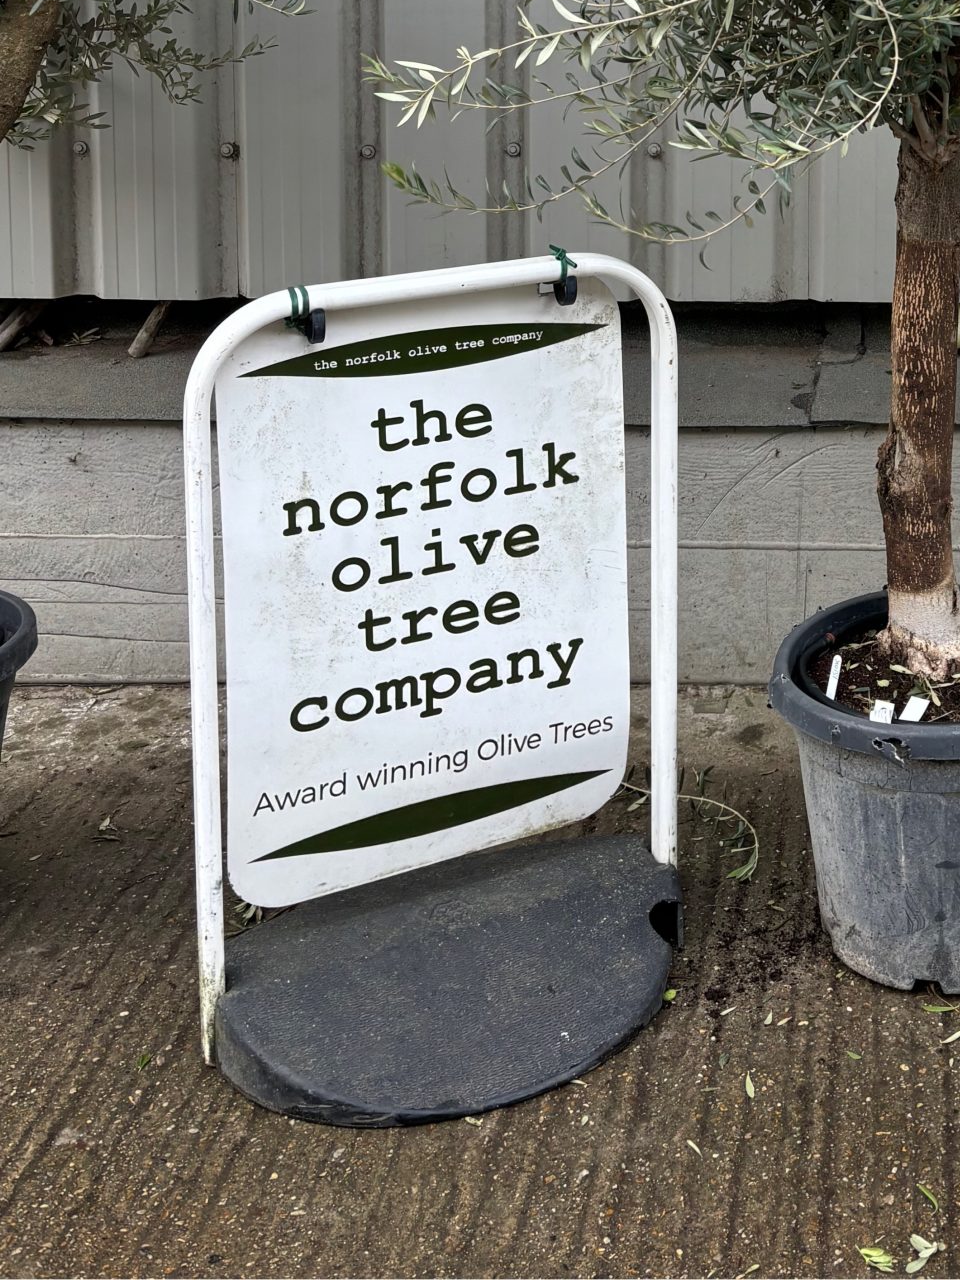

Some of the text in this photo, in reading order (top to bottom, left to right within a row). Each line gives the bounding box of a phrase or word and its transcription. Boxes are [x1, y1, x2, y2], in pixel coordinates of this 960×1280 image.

[313, 331, 544, 371] the norfolk olive tree company
[370, 399, 493, 452] the
[282, 442, 580, 537] norfolk
[331, 523, 540, 593] olive
[357, 590, 521, 652] tree
[289, 637, 584, 733] company
[253, 715, 614, 817] Award winning Olive Trees
